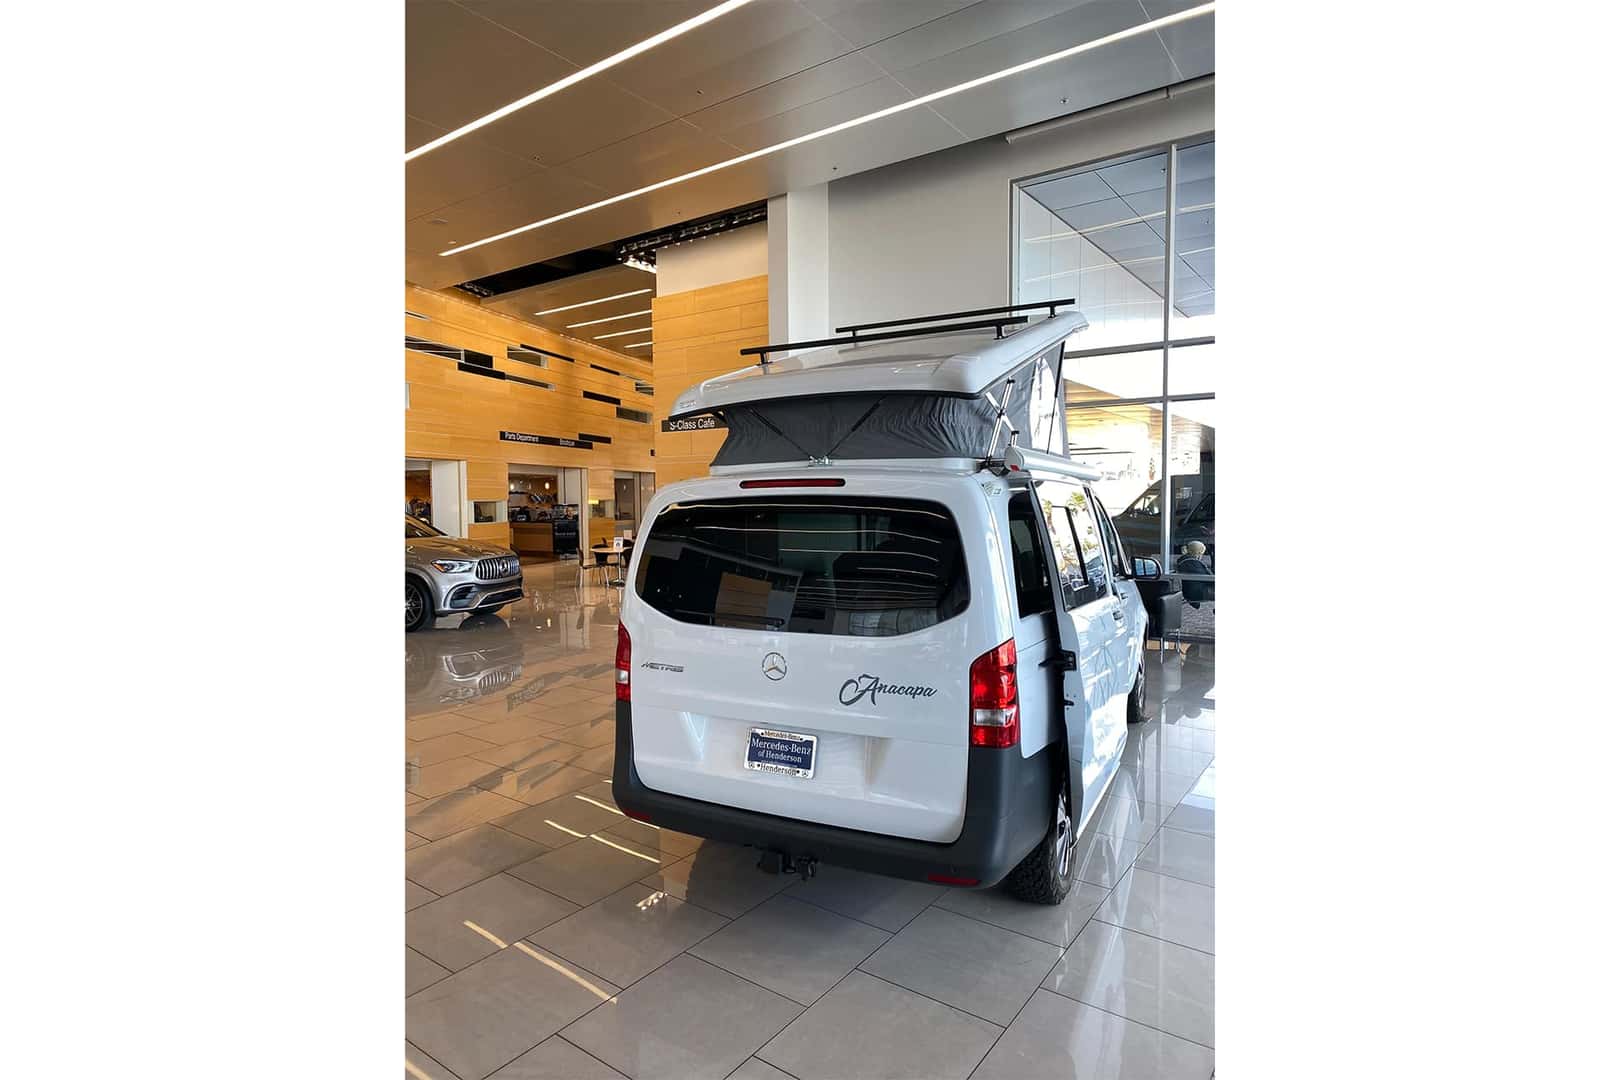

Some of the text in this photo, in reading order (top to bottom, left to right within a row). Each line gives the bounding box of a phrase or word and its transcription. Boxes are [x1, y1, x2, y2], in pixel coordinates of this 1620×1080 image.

[669, 420, 697, 431] S-Class
[504, 431, 540, 443] Parts Department
[839, 673, 938, 706] Anacapa
[751, 737, 812, 755] Mercedes-Benz
[757, 750, 765, 758] of
[765, 750, 802, 764] Henderson
[760, 763, 797, 776] Henderson
